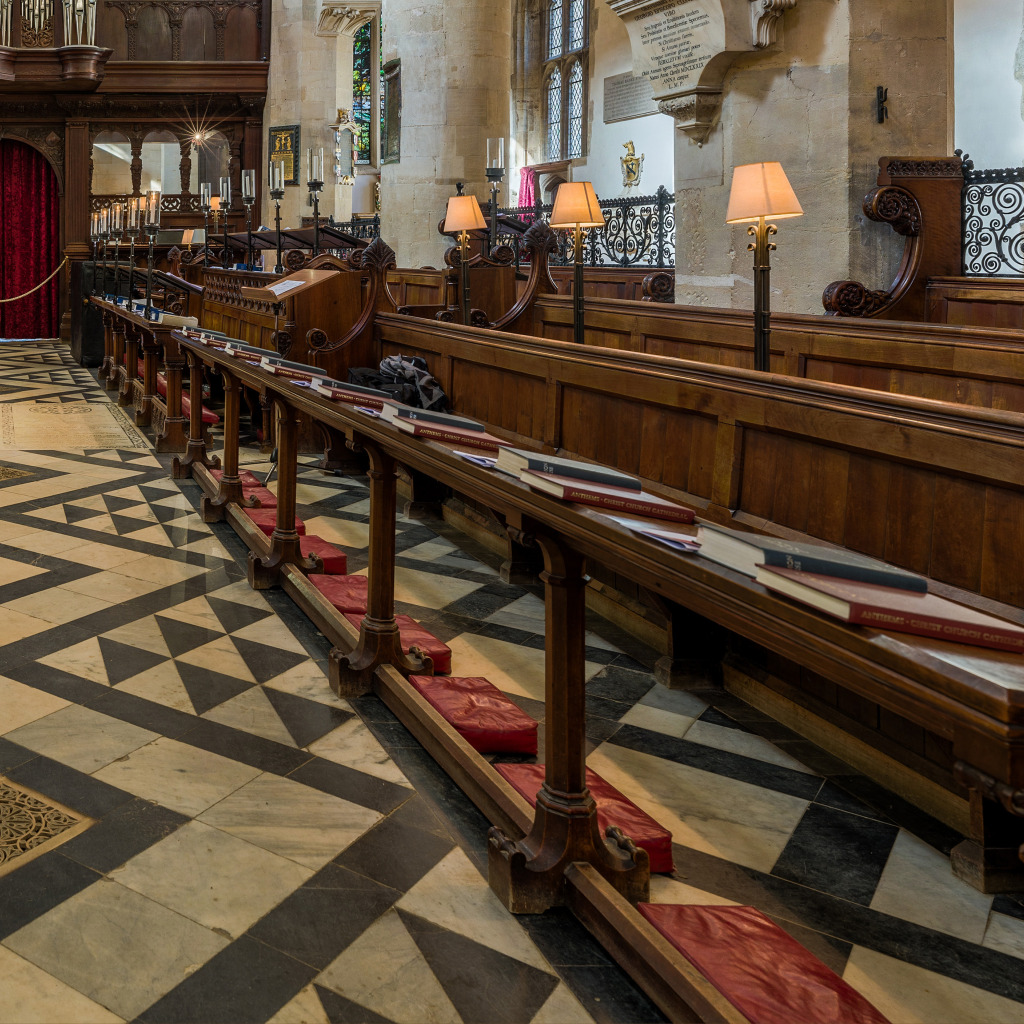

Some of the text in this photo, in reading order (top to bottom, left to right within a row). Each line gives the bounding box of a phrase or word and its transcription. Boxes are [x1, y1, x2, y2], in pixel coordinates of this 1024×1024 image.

[420, 428, 441, 437] ANTHEMS
[444, 433, 461, 441] CHRIST
[461, 437, 480, 445] CHURCH
[570, 491, 688, 520] ANTHEMS CHRIST CHURCH CATHEDRAL
[860, 611, 905, 625] ANTHEMS
[910, 620, 943, 632] CHRIST
[943, 626, 982, 639] CHURCH
